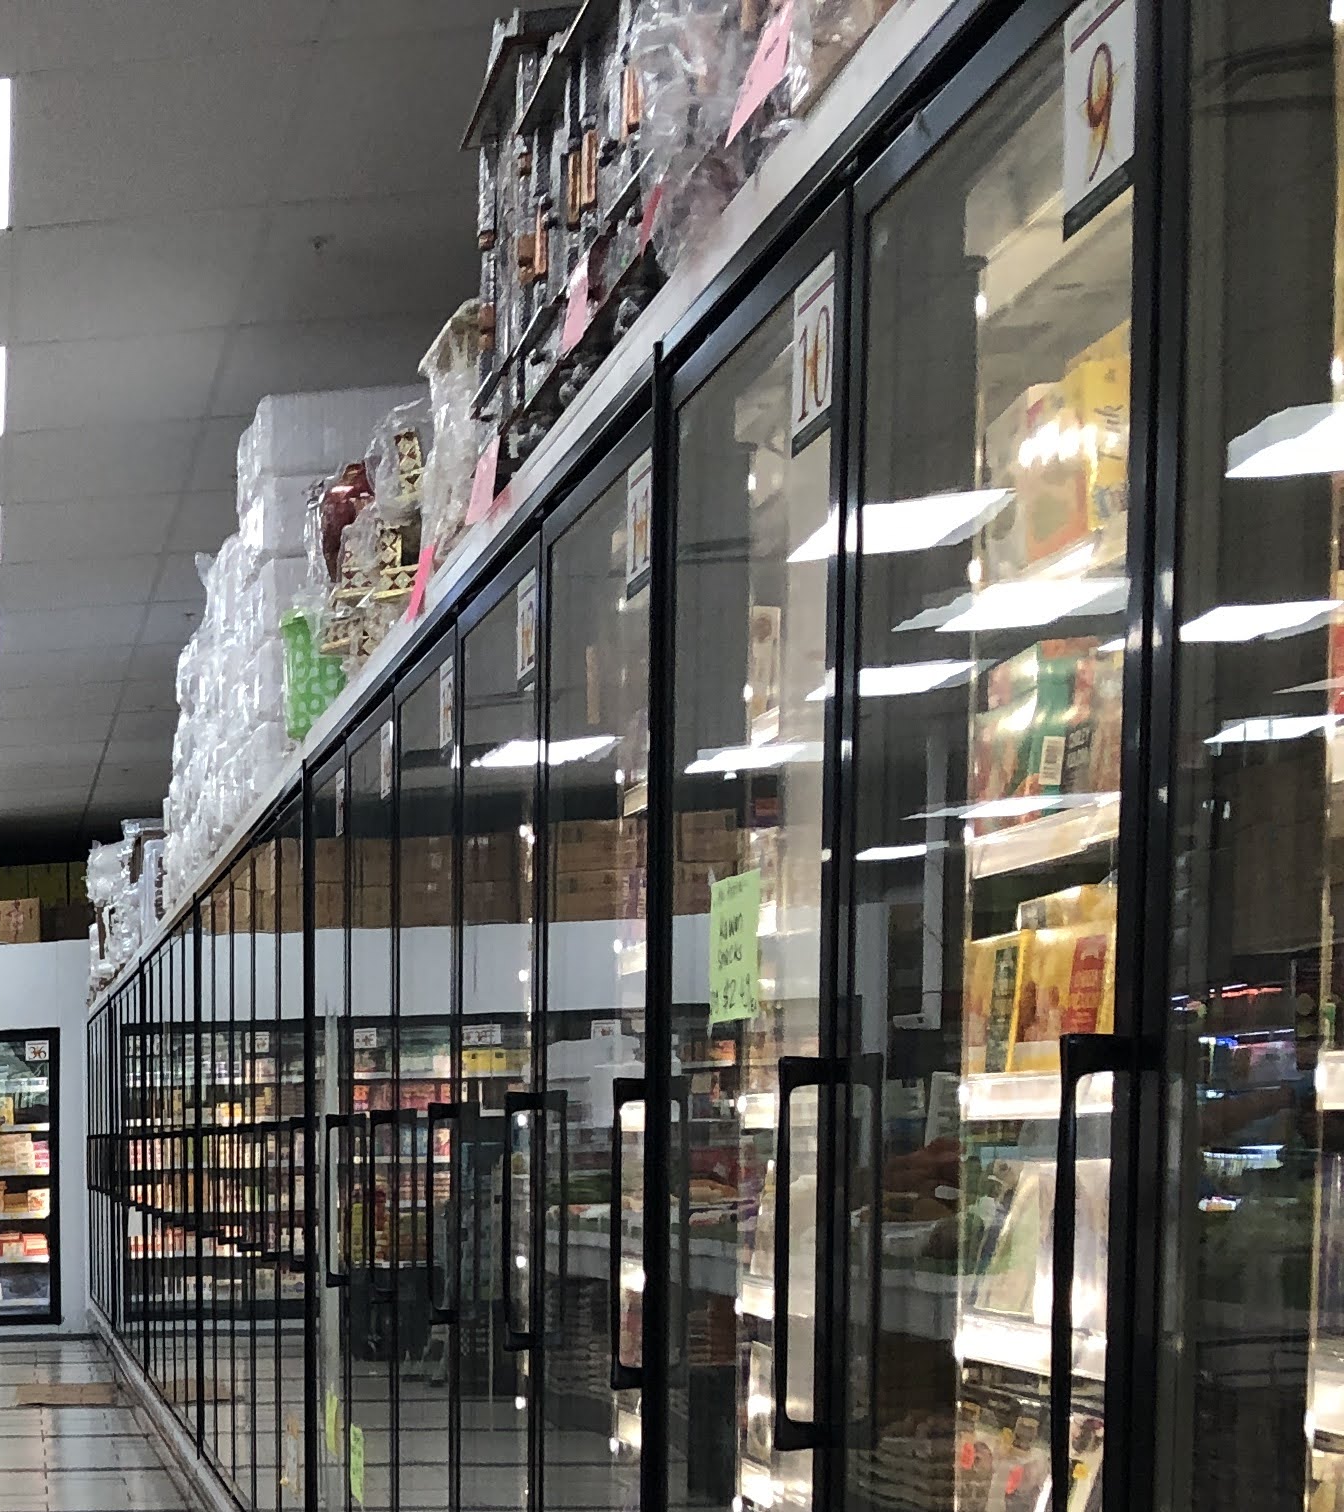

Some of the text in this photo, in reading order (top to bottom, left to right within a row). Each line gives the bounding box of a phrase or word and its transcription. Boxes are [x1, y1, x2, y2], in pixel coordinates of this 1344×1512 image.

[1086, 41, 1113, 183] 9
[797, 304, 831, 423] 10
[630, 486, 650, 575] 11
[27, 1045, 48, 1061] 36
